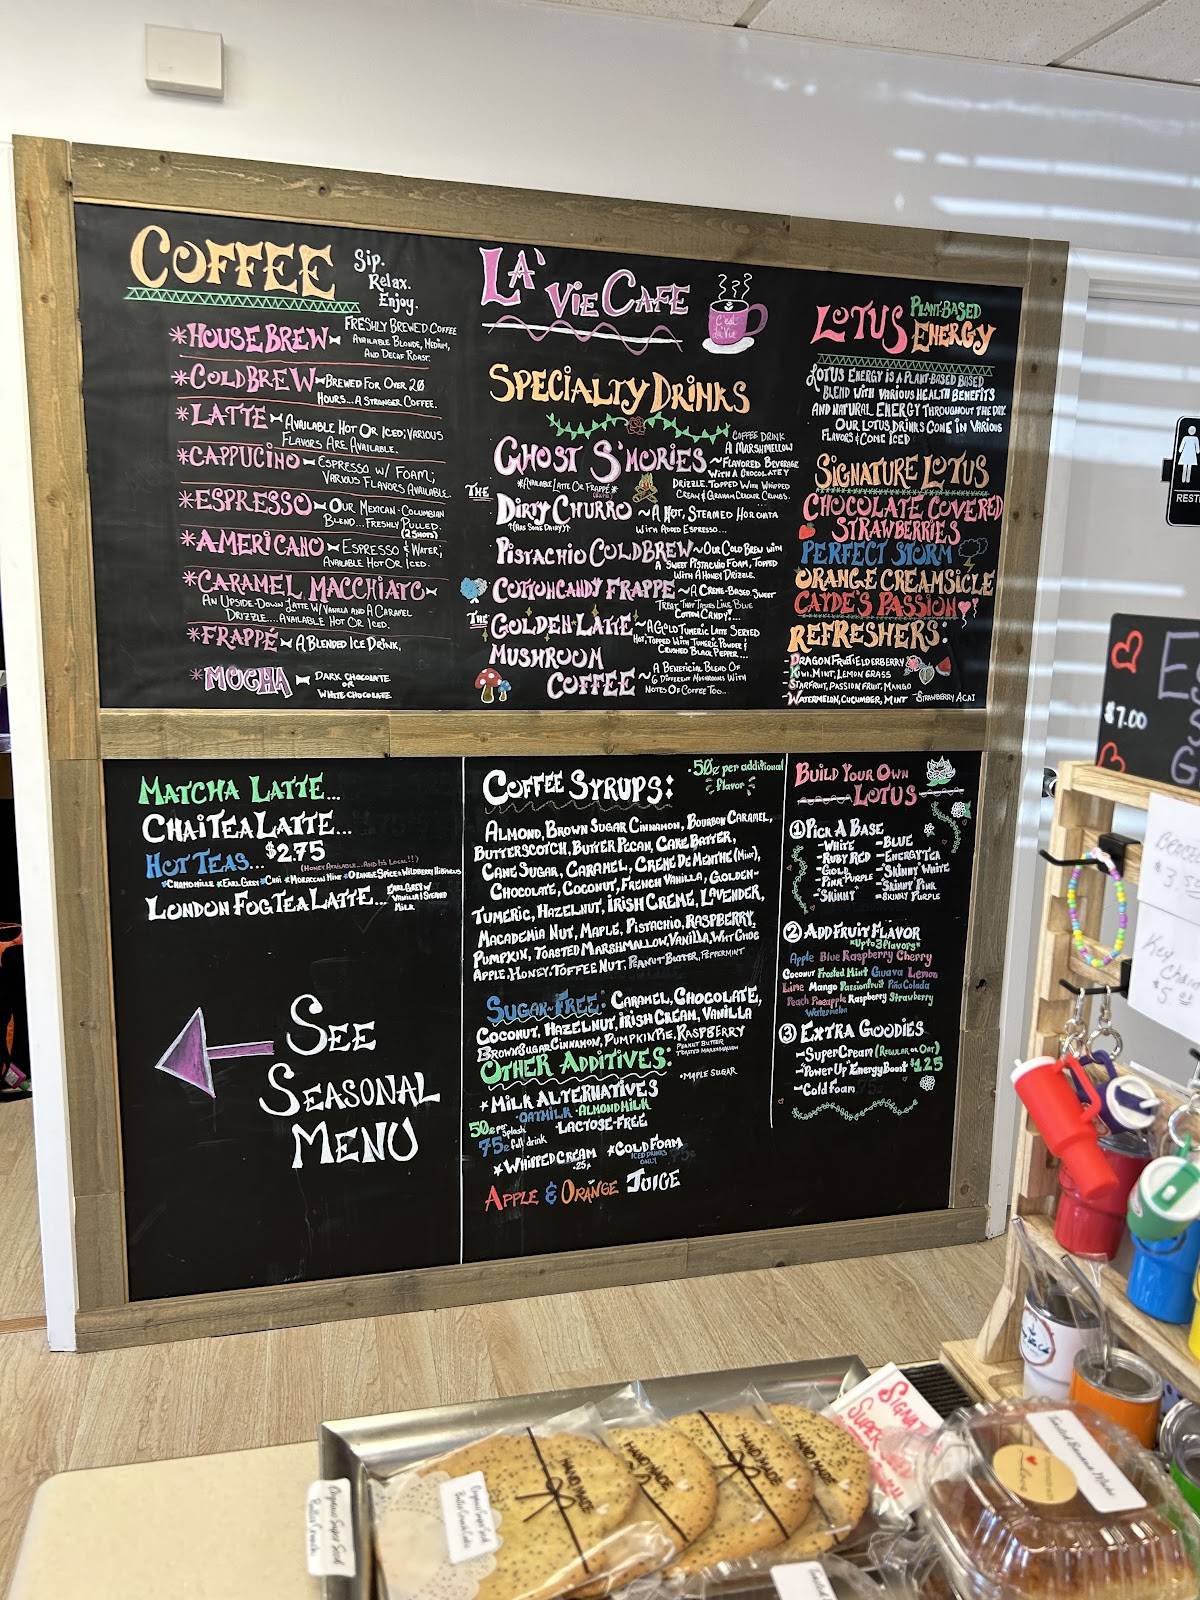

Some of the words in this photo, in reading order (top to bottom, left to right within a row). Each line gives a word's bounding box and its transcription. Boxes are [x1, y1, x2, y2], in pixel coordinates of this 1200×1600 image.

[131, 225, 335, 300] COFFEE
[354, 249, 384, 272] Sip.
[368, 274, 411, 291] Relax.
[602, 269, 690, 317] CAFE
[379, 293, 418, 315] Enjoy.
[389, 318, 429, 334] BREWED
[810, 300, 908, 354] LOTUS
[911, 319, 996, 356] ENERGY
[364, 377, 381, 390] FOR
[190, 403, 267, 429] LATTE
[812, 403, 831, 417] AND
[832, 403, 874, 416] NATURAL
[876, 402, 920, 417] ENERGY
[282, 432, 322, 449] FLAVORS
[327, 435, 348, 450] ARE
[338, 420, 357, 435] HOT
[360, 423, 379, 439] OR
[494, 435, 583, 476] GHOST
[922, 450, 989, 490] LOTUS
[195, 488, 312, 516] ESPRESSO
[465, 484, 490, 498] THE
[552, 494, 633, 524] CHURRO
[803, 495, 924, 521] CHOCOLATE
[927, 496, 1004, 521] COVERED
[800, 540, 888, 566] PERFECT
[890, 543, 953, 566] STORM
[198, 569, 302, 599] CARAMEL
[606, 577, 676, 600] FRAPPE
[795, 567, 877, 591] ORANGE
[202, 626, 279, 652] FRAPPÉ
[491, 613, 571, 639] GOLDEN
[575, 613, 634, 637] LATTE
[787, 619, 947, 653] REFRESHERS:
[489, 643, 604, 669] MUSHROOM
[204, 666, 293, 698] MOCHA
[547, 667, 636, 699] COFFEE
[1104, 701, 1147, 729] $7.00
[721, 764, 739, 777] per
[877, 764, 908, 782] OWN
[138, 775, 240, 805] MATCHA
[482, 769, 564, 805] COFFEE
[569, 769, 674, 804] SYRUPS:
[716, 779, 745, 790] flavor
[853, 783, 917, 806] LOTUS
[485, 820, 544, 842] ALMOND,
[546, 820, 588, 838] BROWN
[590, 819, 627, 833] SUGAR
[835, 819, 847, 837] A
[850, 818, 884, 837] BASE
[265, 839, 325, 863] $2.75
[572, 840, 615, 856] BUTTER
[145, 852, 190, 879] HOT
[145, 895, 230, 920] LONDON
[234, 890, 274, 915] FOG
[272, 889, 310, 913] TEA
[871, 922, 921, 940] FLAVOR
[286, 994, 376, 1056] SEE
[800, 1020, 855, 1043] EXTRA
[480, 1053, 554, 1085] OTHER
[259, 1063, 440, 1116] SEASONAL
[292, 1117, 418, 1168] MENU
[485, 1185, 539, 1212] APPLE
[561, 1179, 619, 1204] ORANGE
[627, 1168, 680, 1194] JUICE
[625, 1440, 650, 1469] HAND
[738, 1432, 763, 1461] HAND
[758, 1458, 783, 1487] MADE
